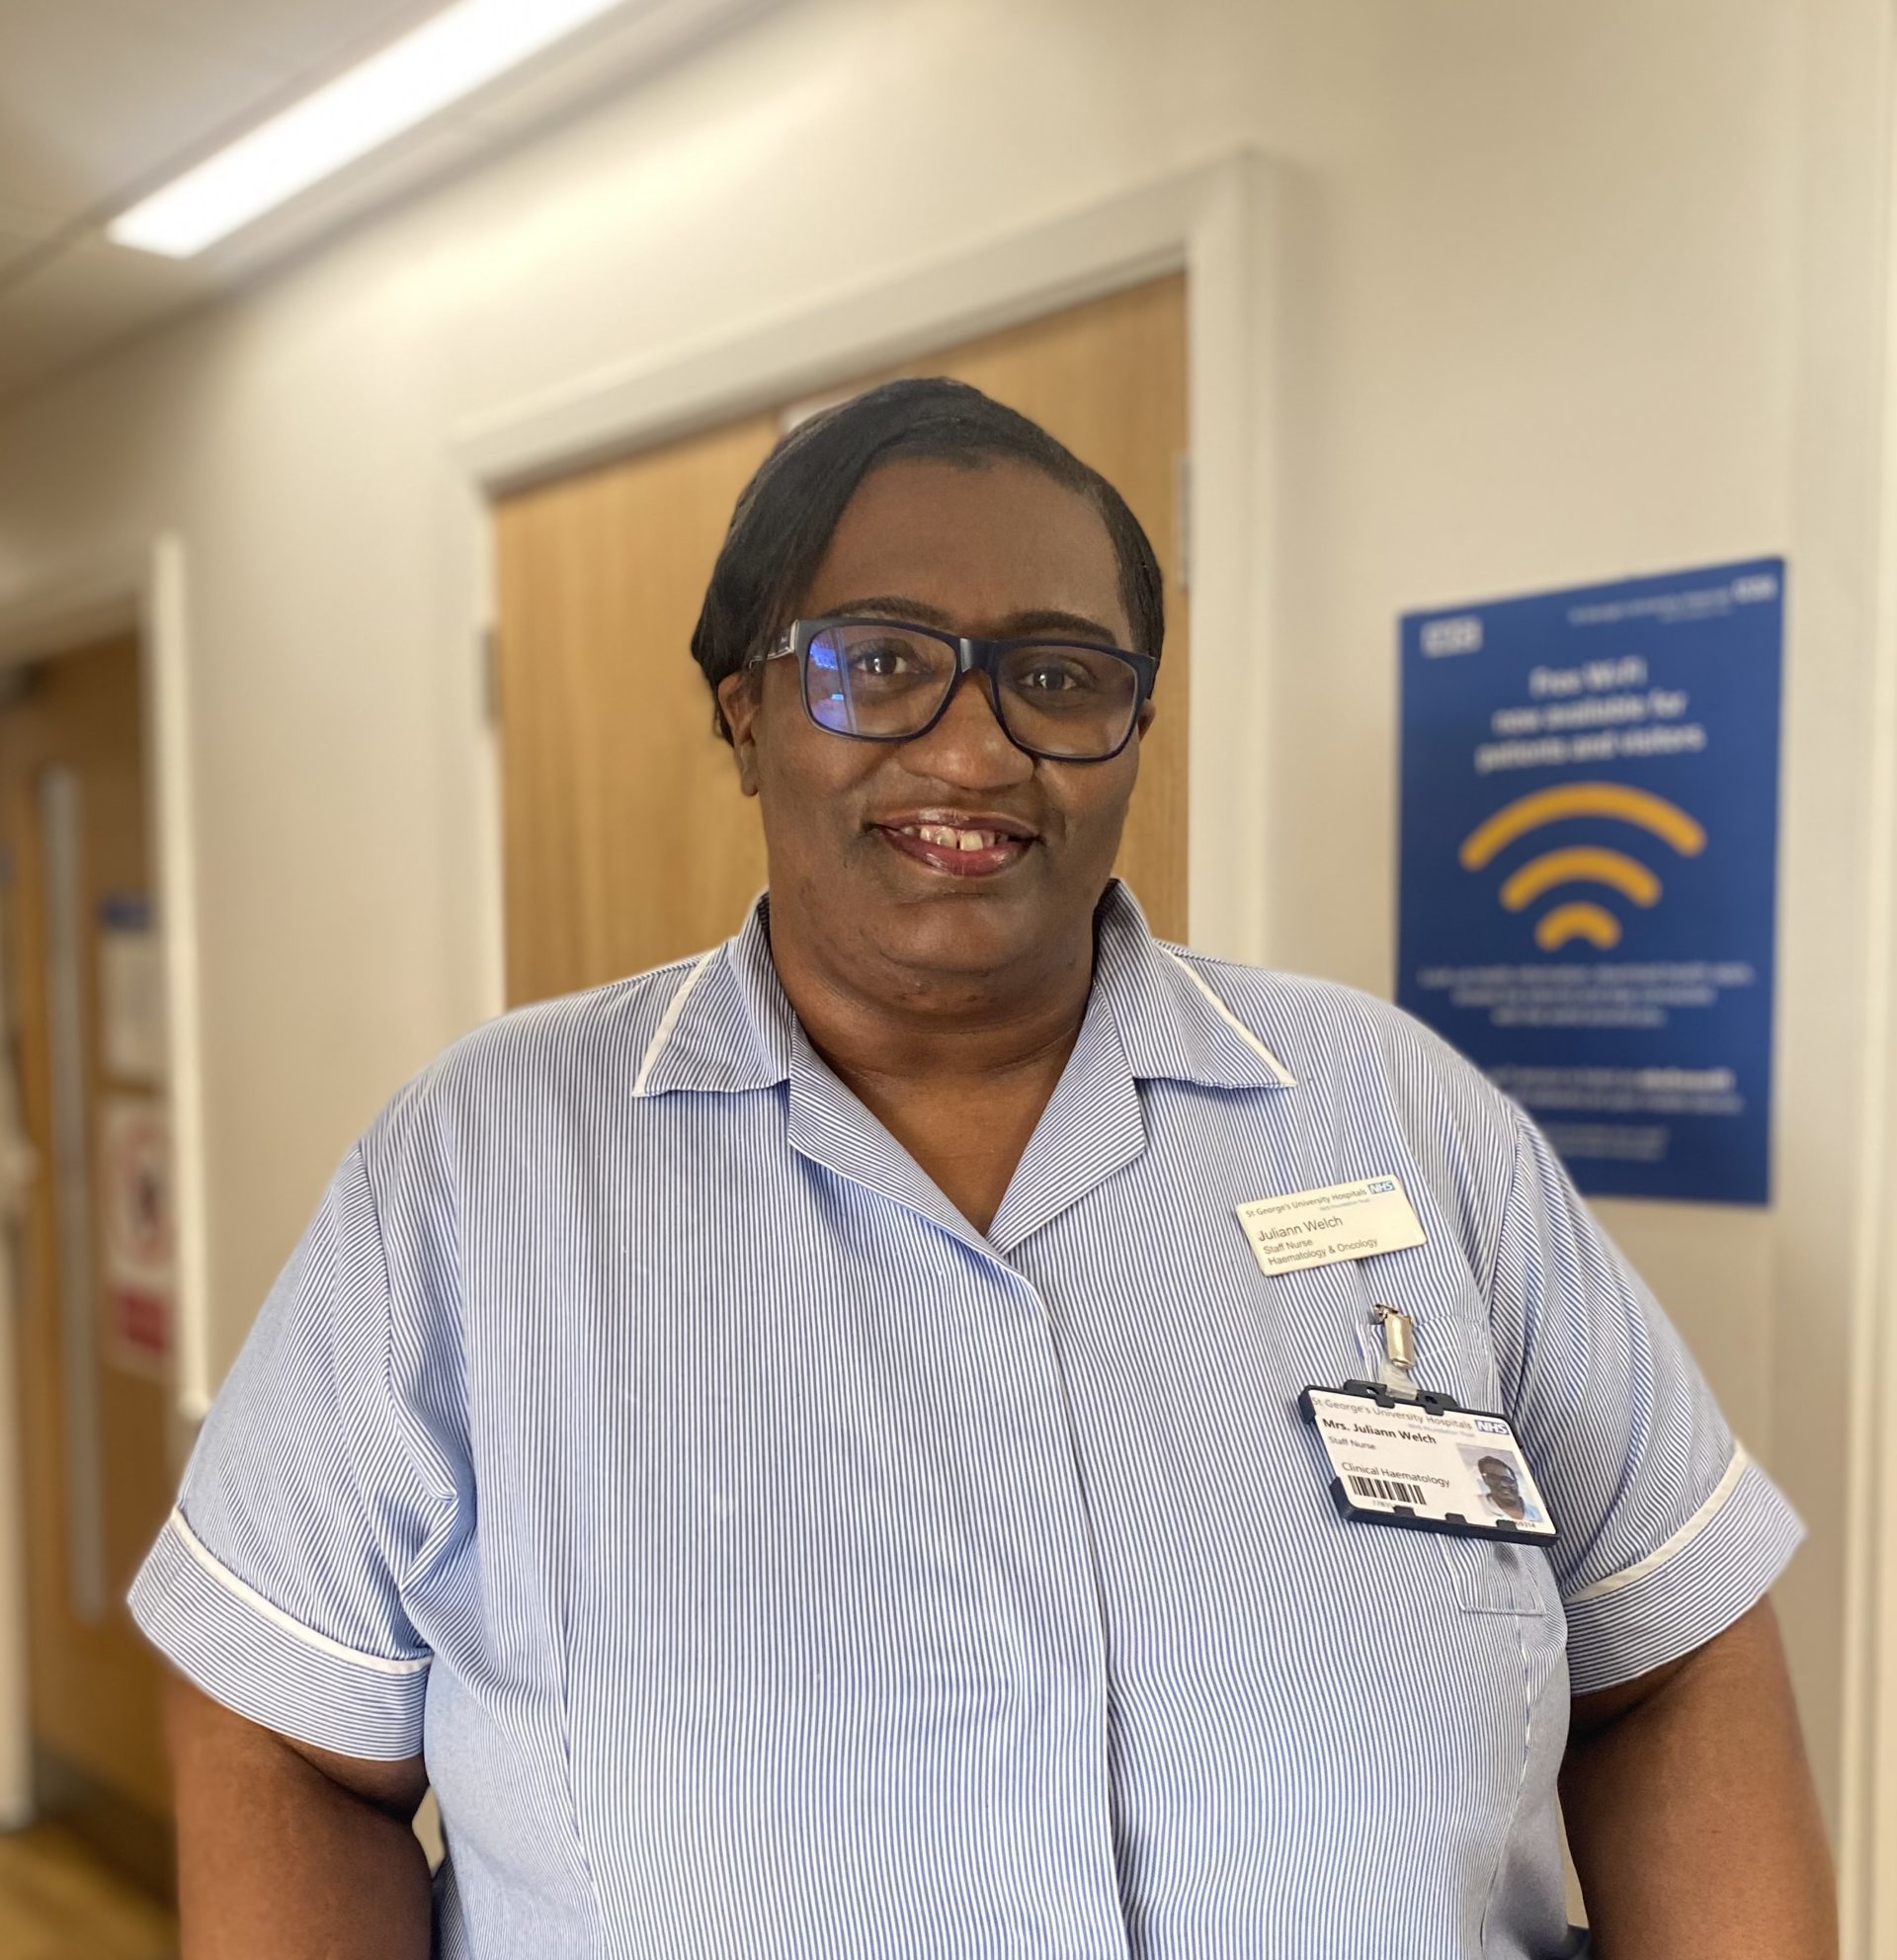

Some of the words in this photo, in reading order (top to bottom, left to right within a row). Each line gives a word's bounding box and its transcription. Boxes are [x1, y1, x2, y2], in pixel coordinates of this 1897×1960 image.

[1542, 693, 1647, 729] available
[1475, 735, 1569, 775] patients
[1571, 729, 1617, 763] and
[1620, 722, 1707, 756] visitors
[1245, 1209, 1255, 1218] St
[1256, 1203, 1290, 1216] George's
[1291, 1195, 1330, 1209] University
[1331, 1188, 1366, 1201] Hospitals
[1369, 1181, 1394, 1193] NHS
[1258, 1225, 1302, 1242] Juliann
[1303, 1216, 1343, 1232] Welch
[1263, 1243, 1285, 1255] Staff
[1286, 1239, 1313, 1250] Nurse
[1268, 1249, 1326, 1266] Haematology
[1328, 1245, 1336, 1255] &
[1337, 1239, 1377, 1253] Oncology
[1312, 1397, 1322, 1406] St
[1324, 1399, 1370, 1414] George's
[1372, 1407, 1424, 1423] University
[1426, 1417, 1472, 1429] Hospitals
[1475, 1420, 1510, 1435] NHS
[1322, 1418, 1351, 1431] Mrs.
[1353, 1423, 1397, 1438] Juliann
[1398, 1430, 1437, 1444] Welch
[1328, 1436, 1349, 1446] Staff
[1351, 1439, 1376, 1450] Nurse
[1341, 1462, 1379, 1476] Clinical
[1380, 1468, 1449, 1487] Haematology
